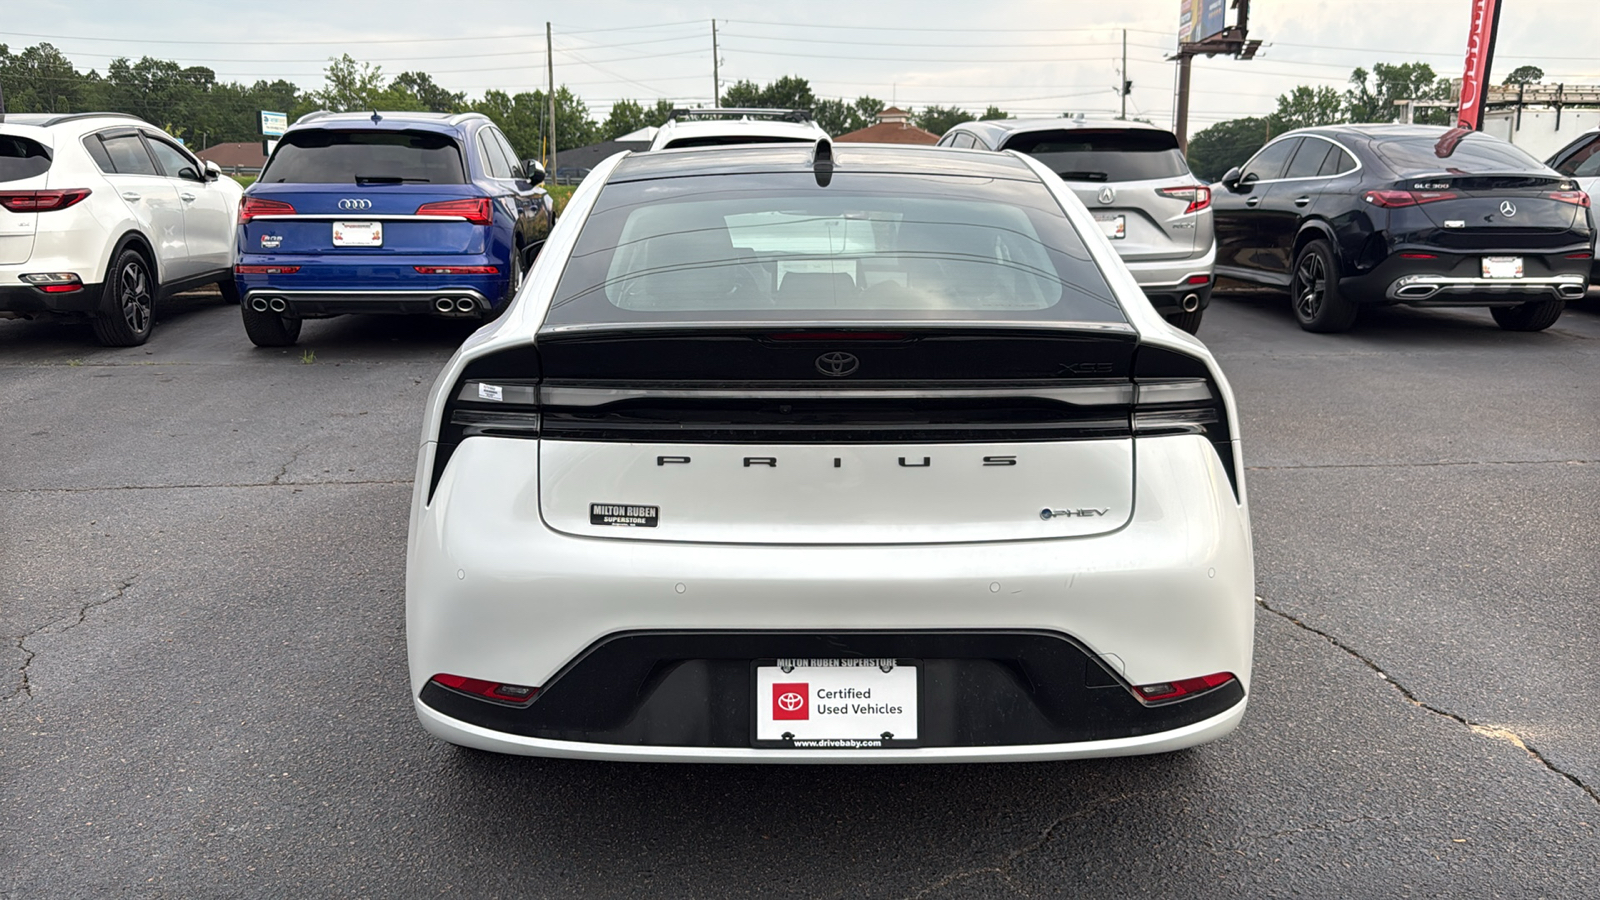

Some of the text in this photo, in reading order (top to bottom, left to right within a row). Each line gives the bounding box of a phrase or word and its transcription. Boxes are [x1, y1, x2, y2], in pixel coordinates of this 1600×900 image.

[1057, 362, 1113, 374] XSE
[656, 456, 1017, 468] PRIUS
[593, 505, 656, 518] MILTON RUBEN
[776, 658, 898, 667] MILTON RUBEN SUPERSTORE
[816, 687, 871, 699] Certified
[817, 703, 903, 715] Used Vehicles
[794, 739, 882, 748] www.drivebaby.com
